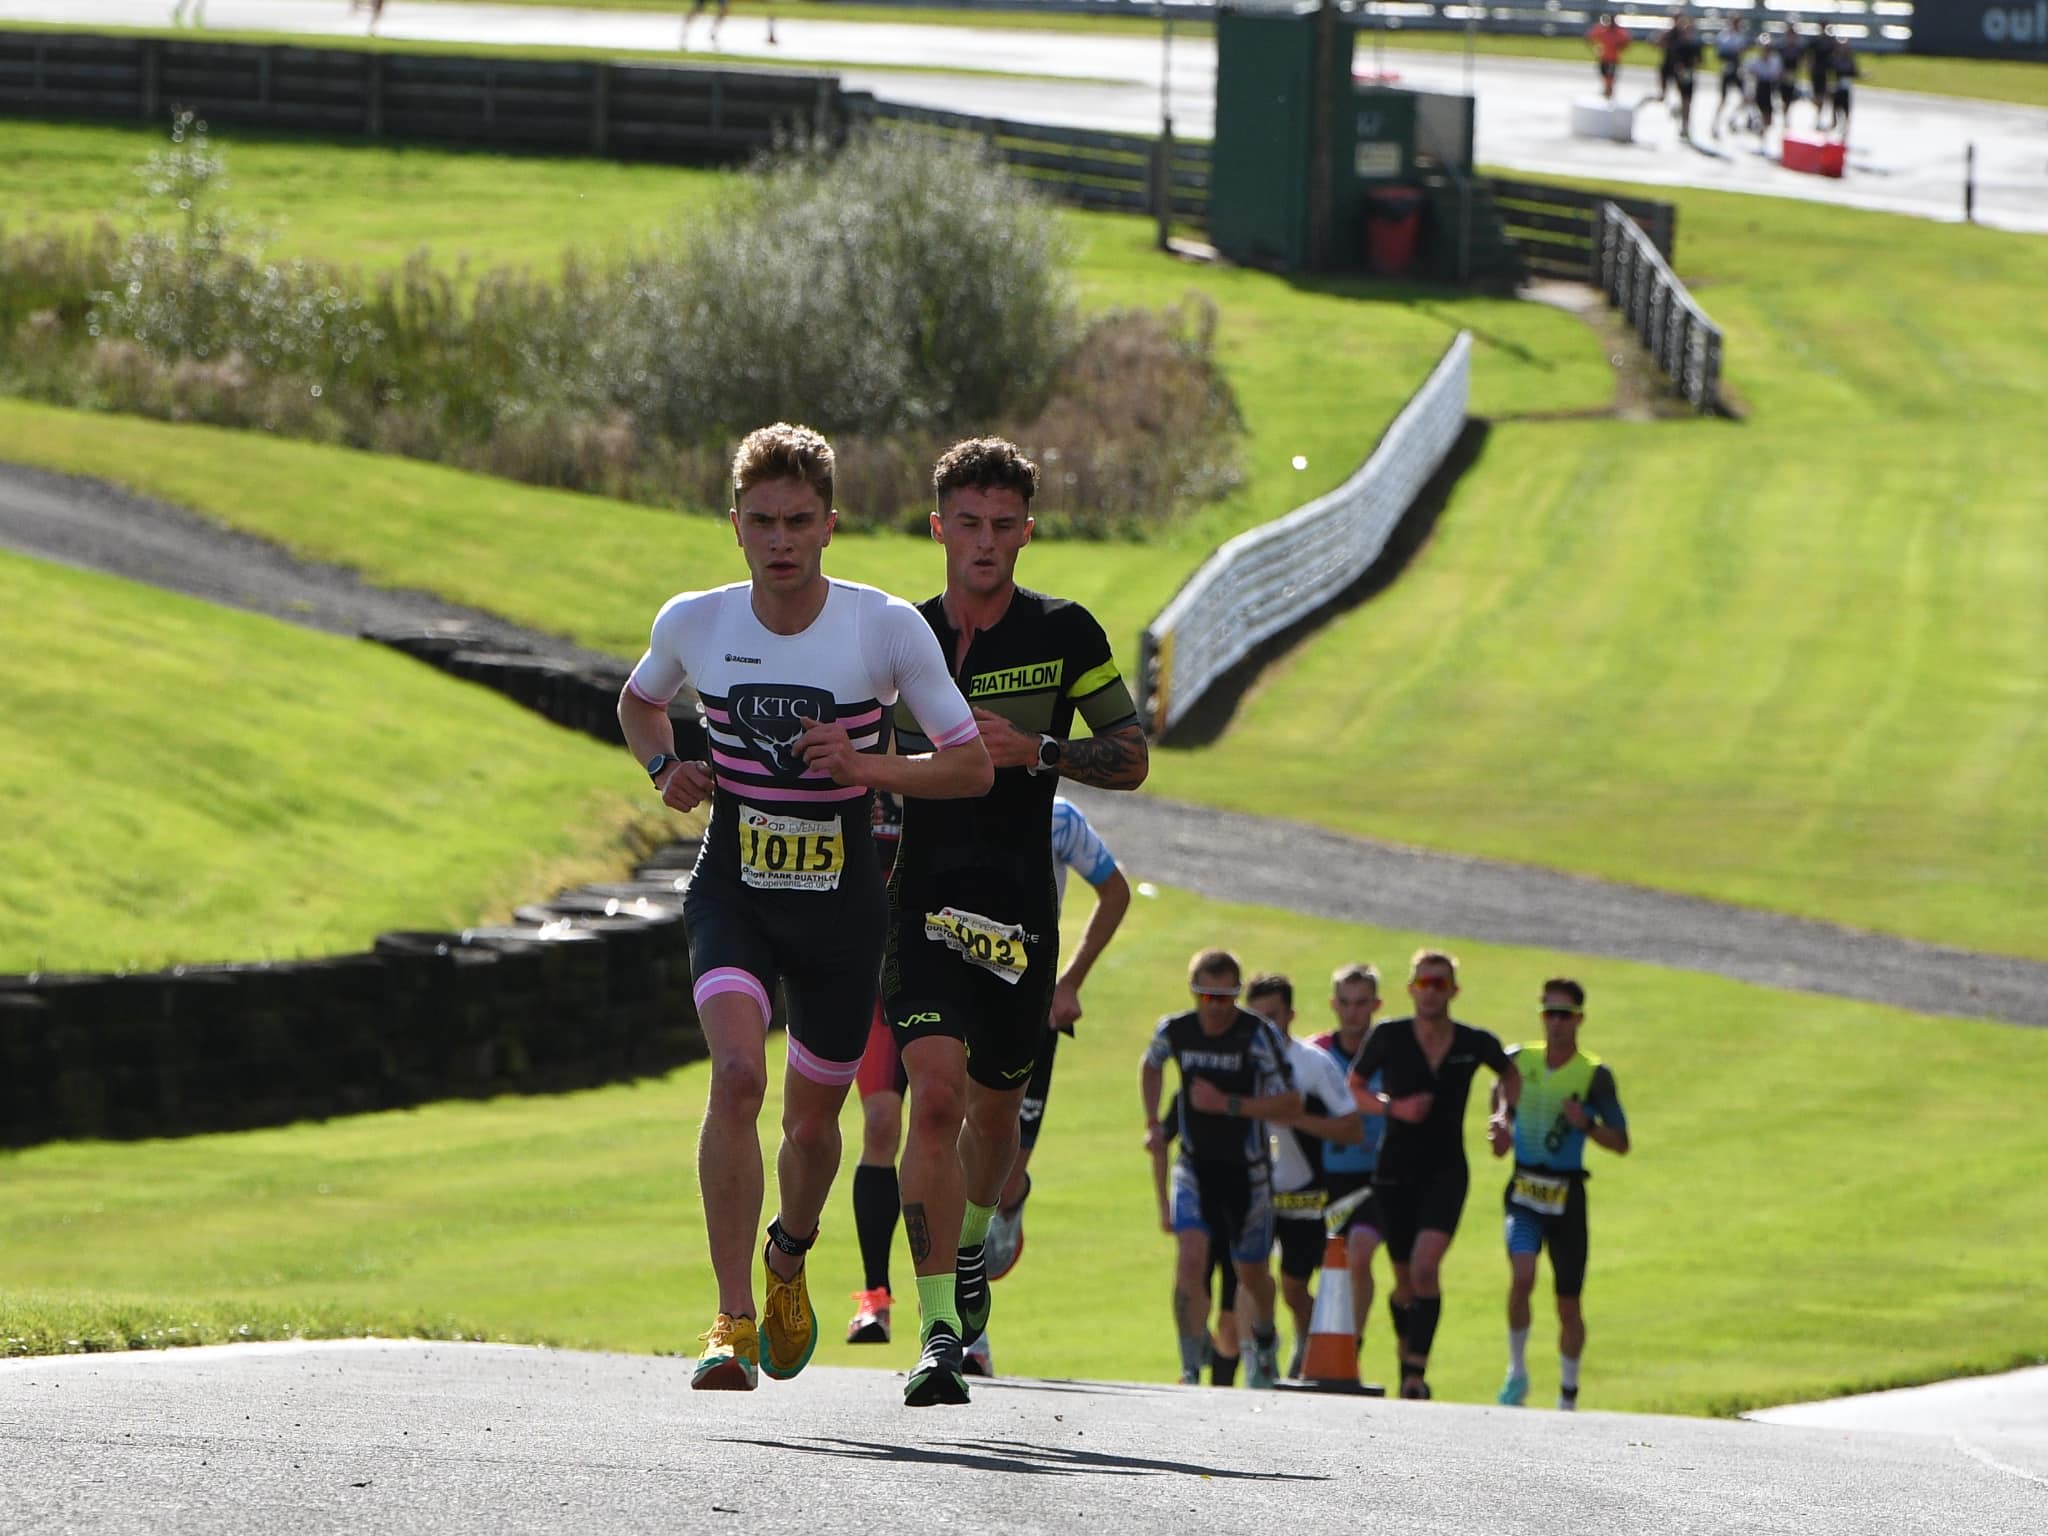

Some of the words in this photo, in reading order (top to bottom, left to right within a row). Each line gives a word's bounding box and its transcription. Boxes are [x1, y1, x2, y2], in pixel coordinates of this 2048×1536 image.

[750, 695, 808, 720] KTC
[750, 829, 834, 871] 1015
[767, 872, 793, 880] PARK
[897, 1012, 942, 1029] VX3
